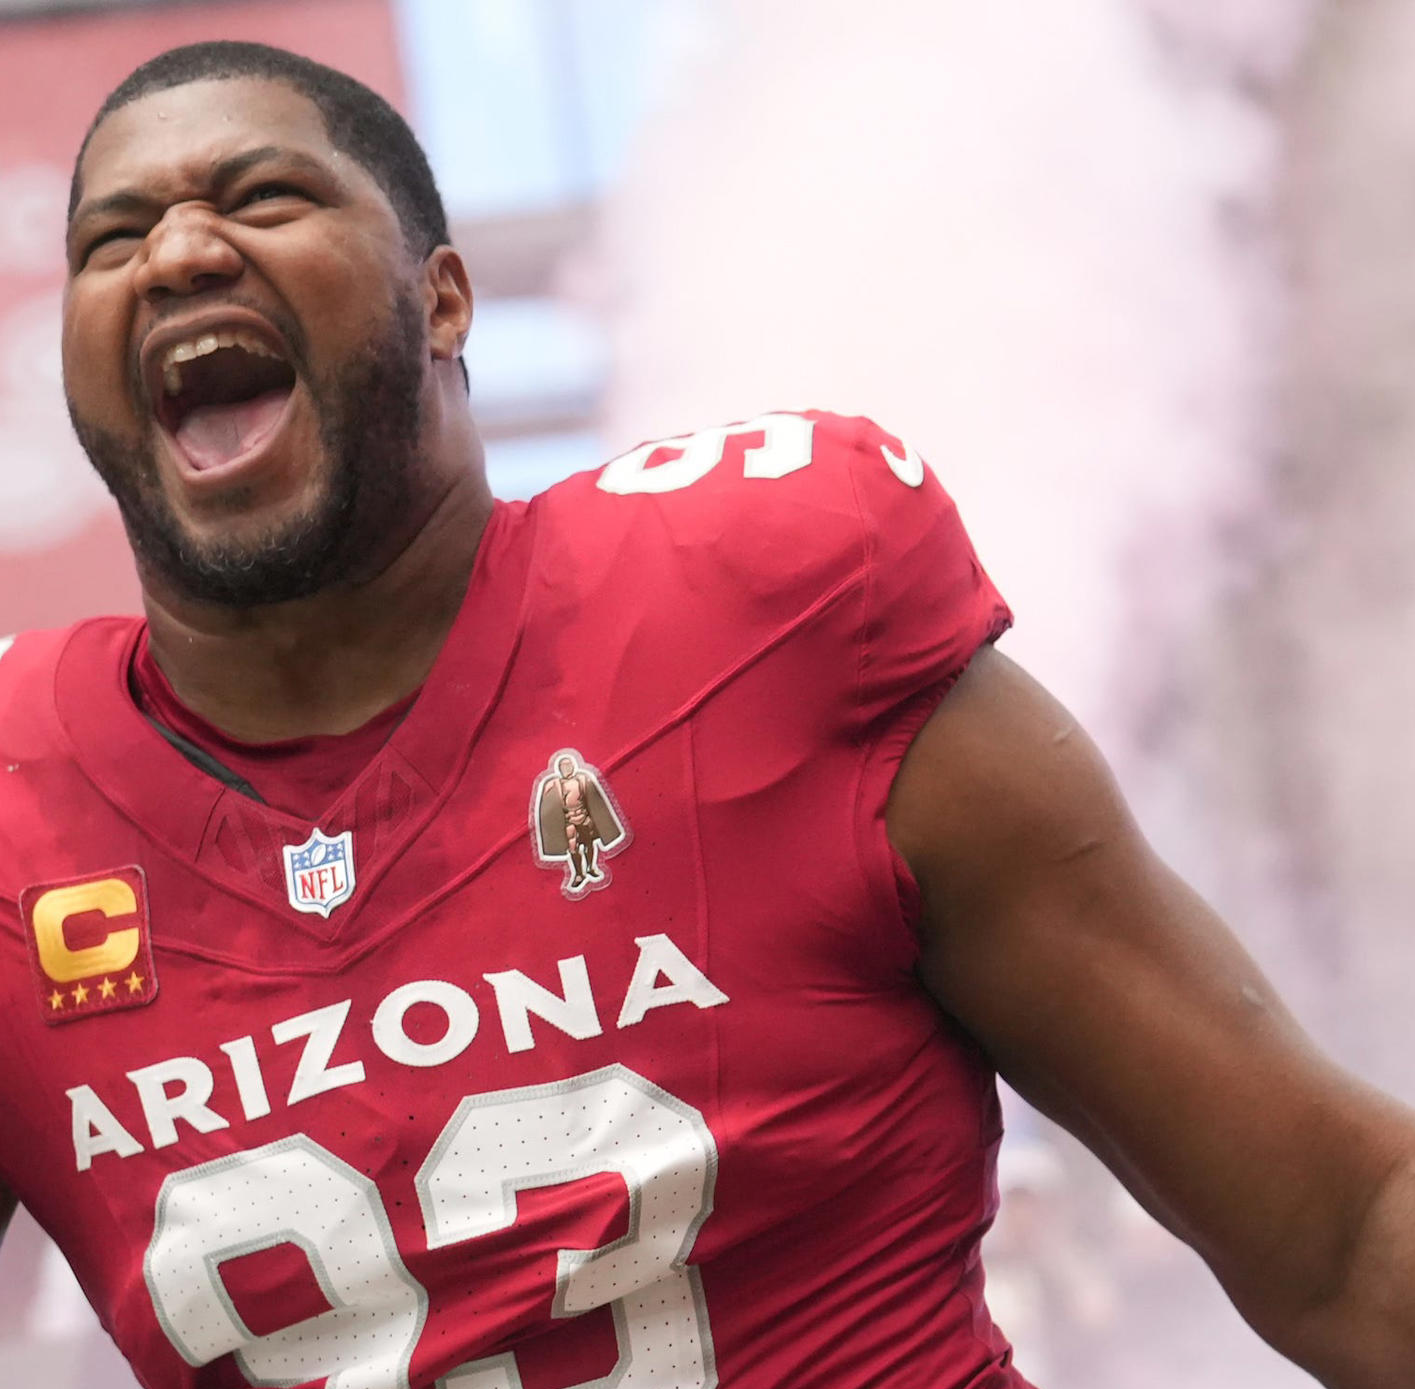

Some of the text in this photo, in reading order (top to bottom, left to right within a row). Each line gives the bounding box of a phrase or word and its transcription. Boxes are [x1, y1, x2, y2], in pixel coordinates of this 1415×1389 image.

[33, 876, 141, 984] C
[300, 866, 344, 900] NFL
[66, 932, 730, 1171] ARIZONA
